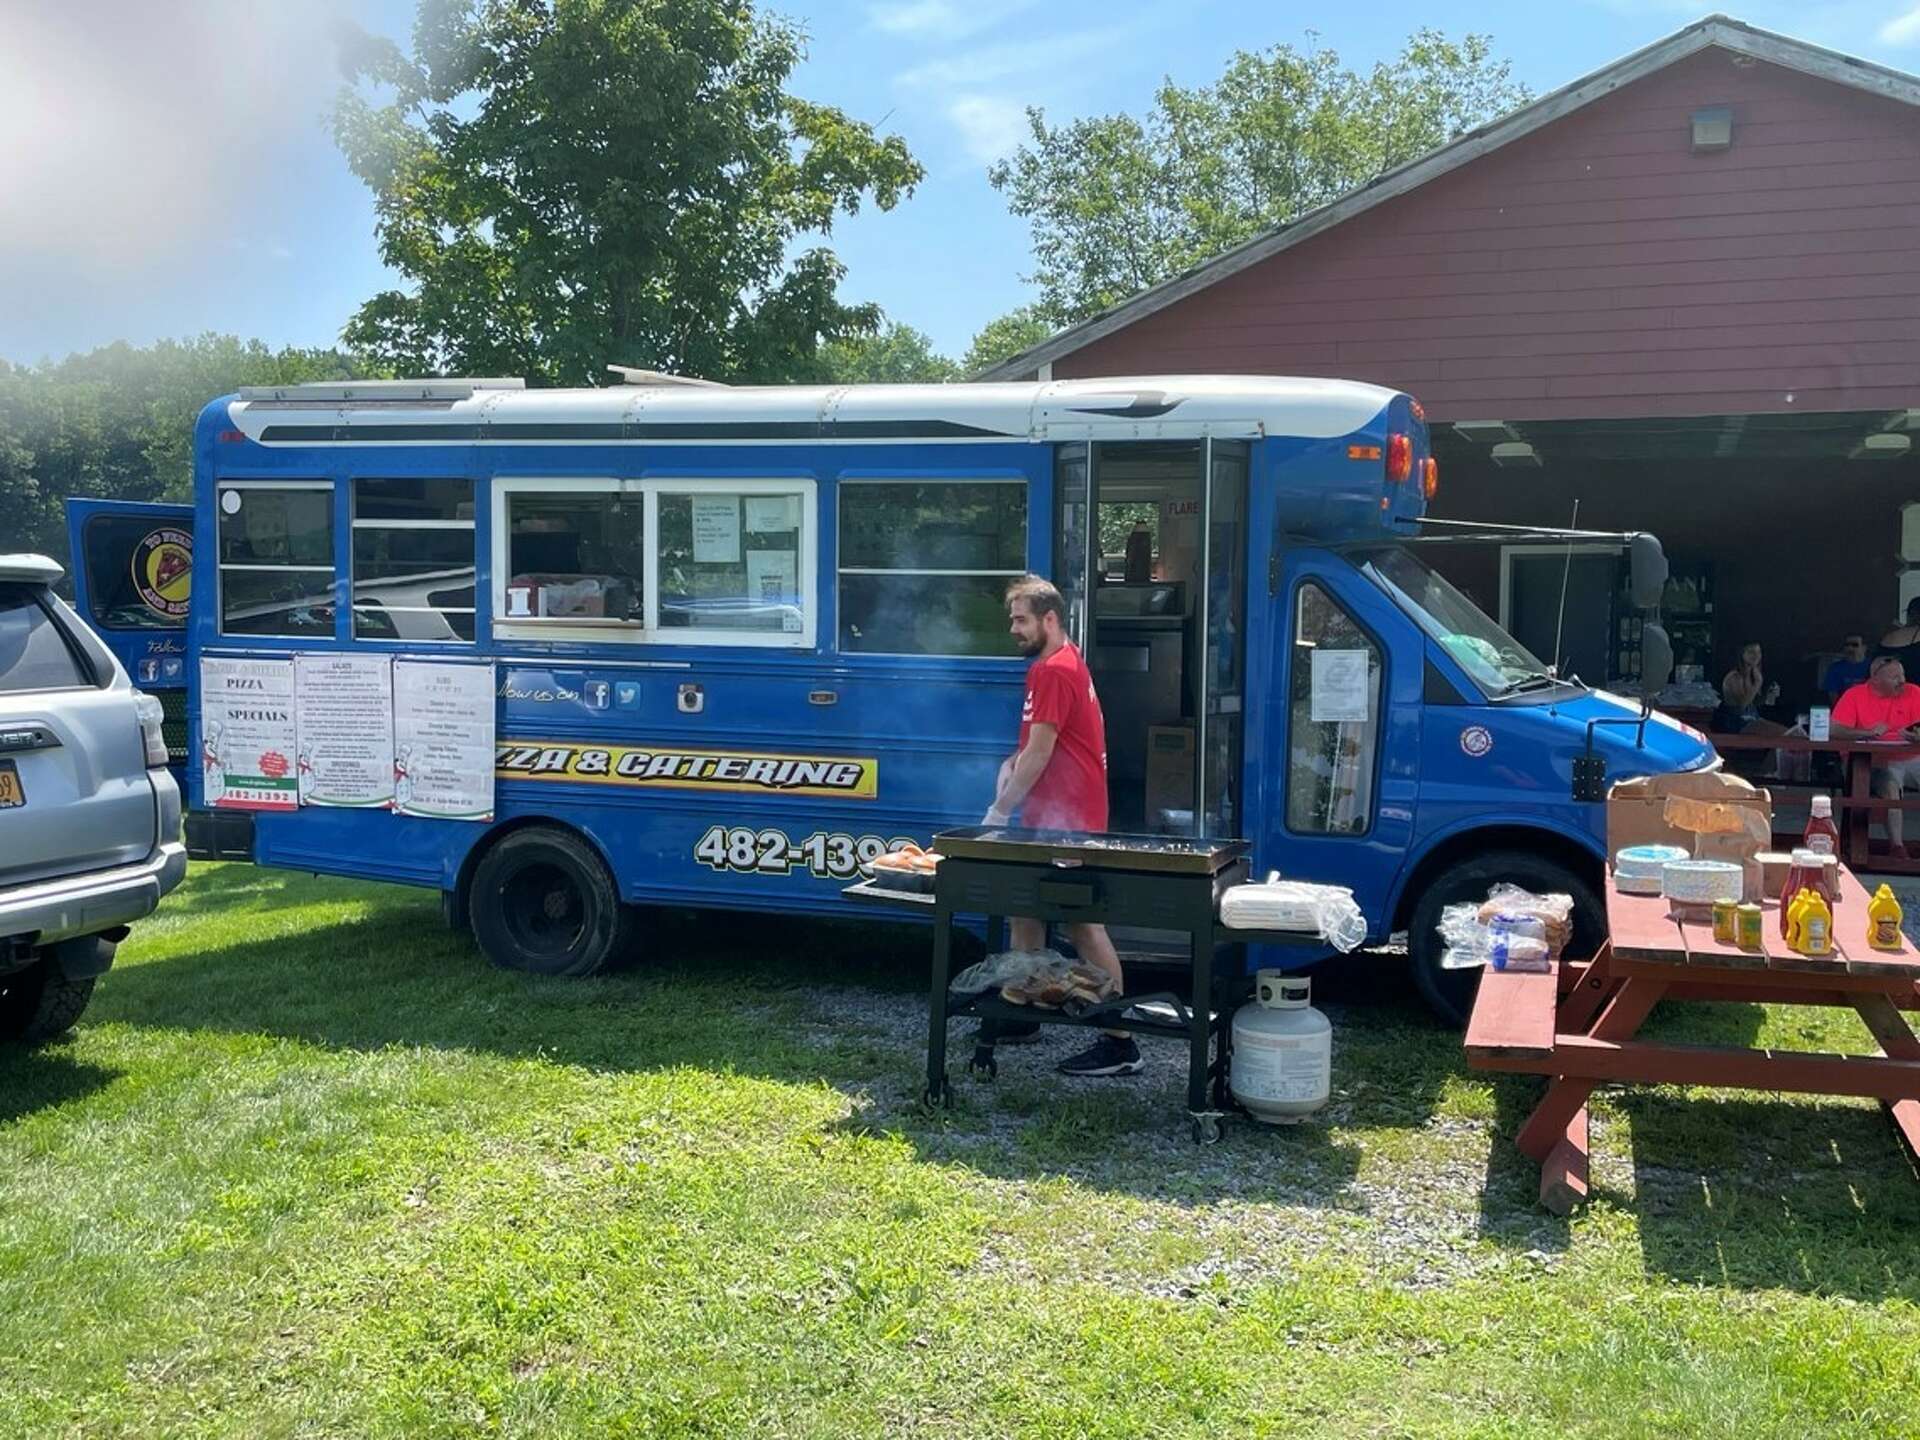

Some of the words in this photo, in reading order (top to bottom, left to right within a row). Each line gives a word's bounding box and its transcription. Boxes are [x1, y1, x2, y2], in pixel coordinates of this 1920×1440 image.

[226, 678, 264, 689] PIZZA
[227, 709, 288, 722] SPECIALS
[576, 749, 611, 775] &
[616, 752, 864, 789] CATERING
